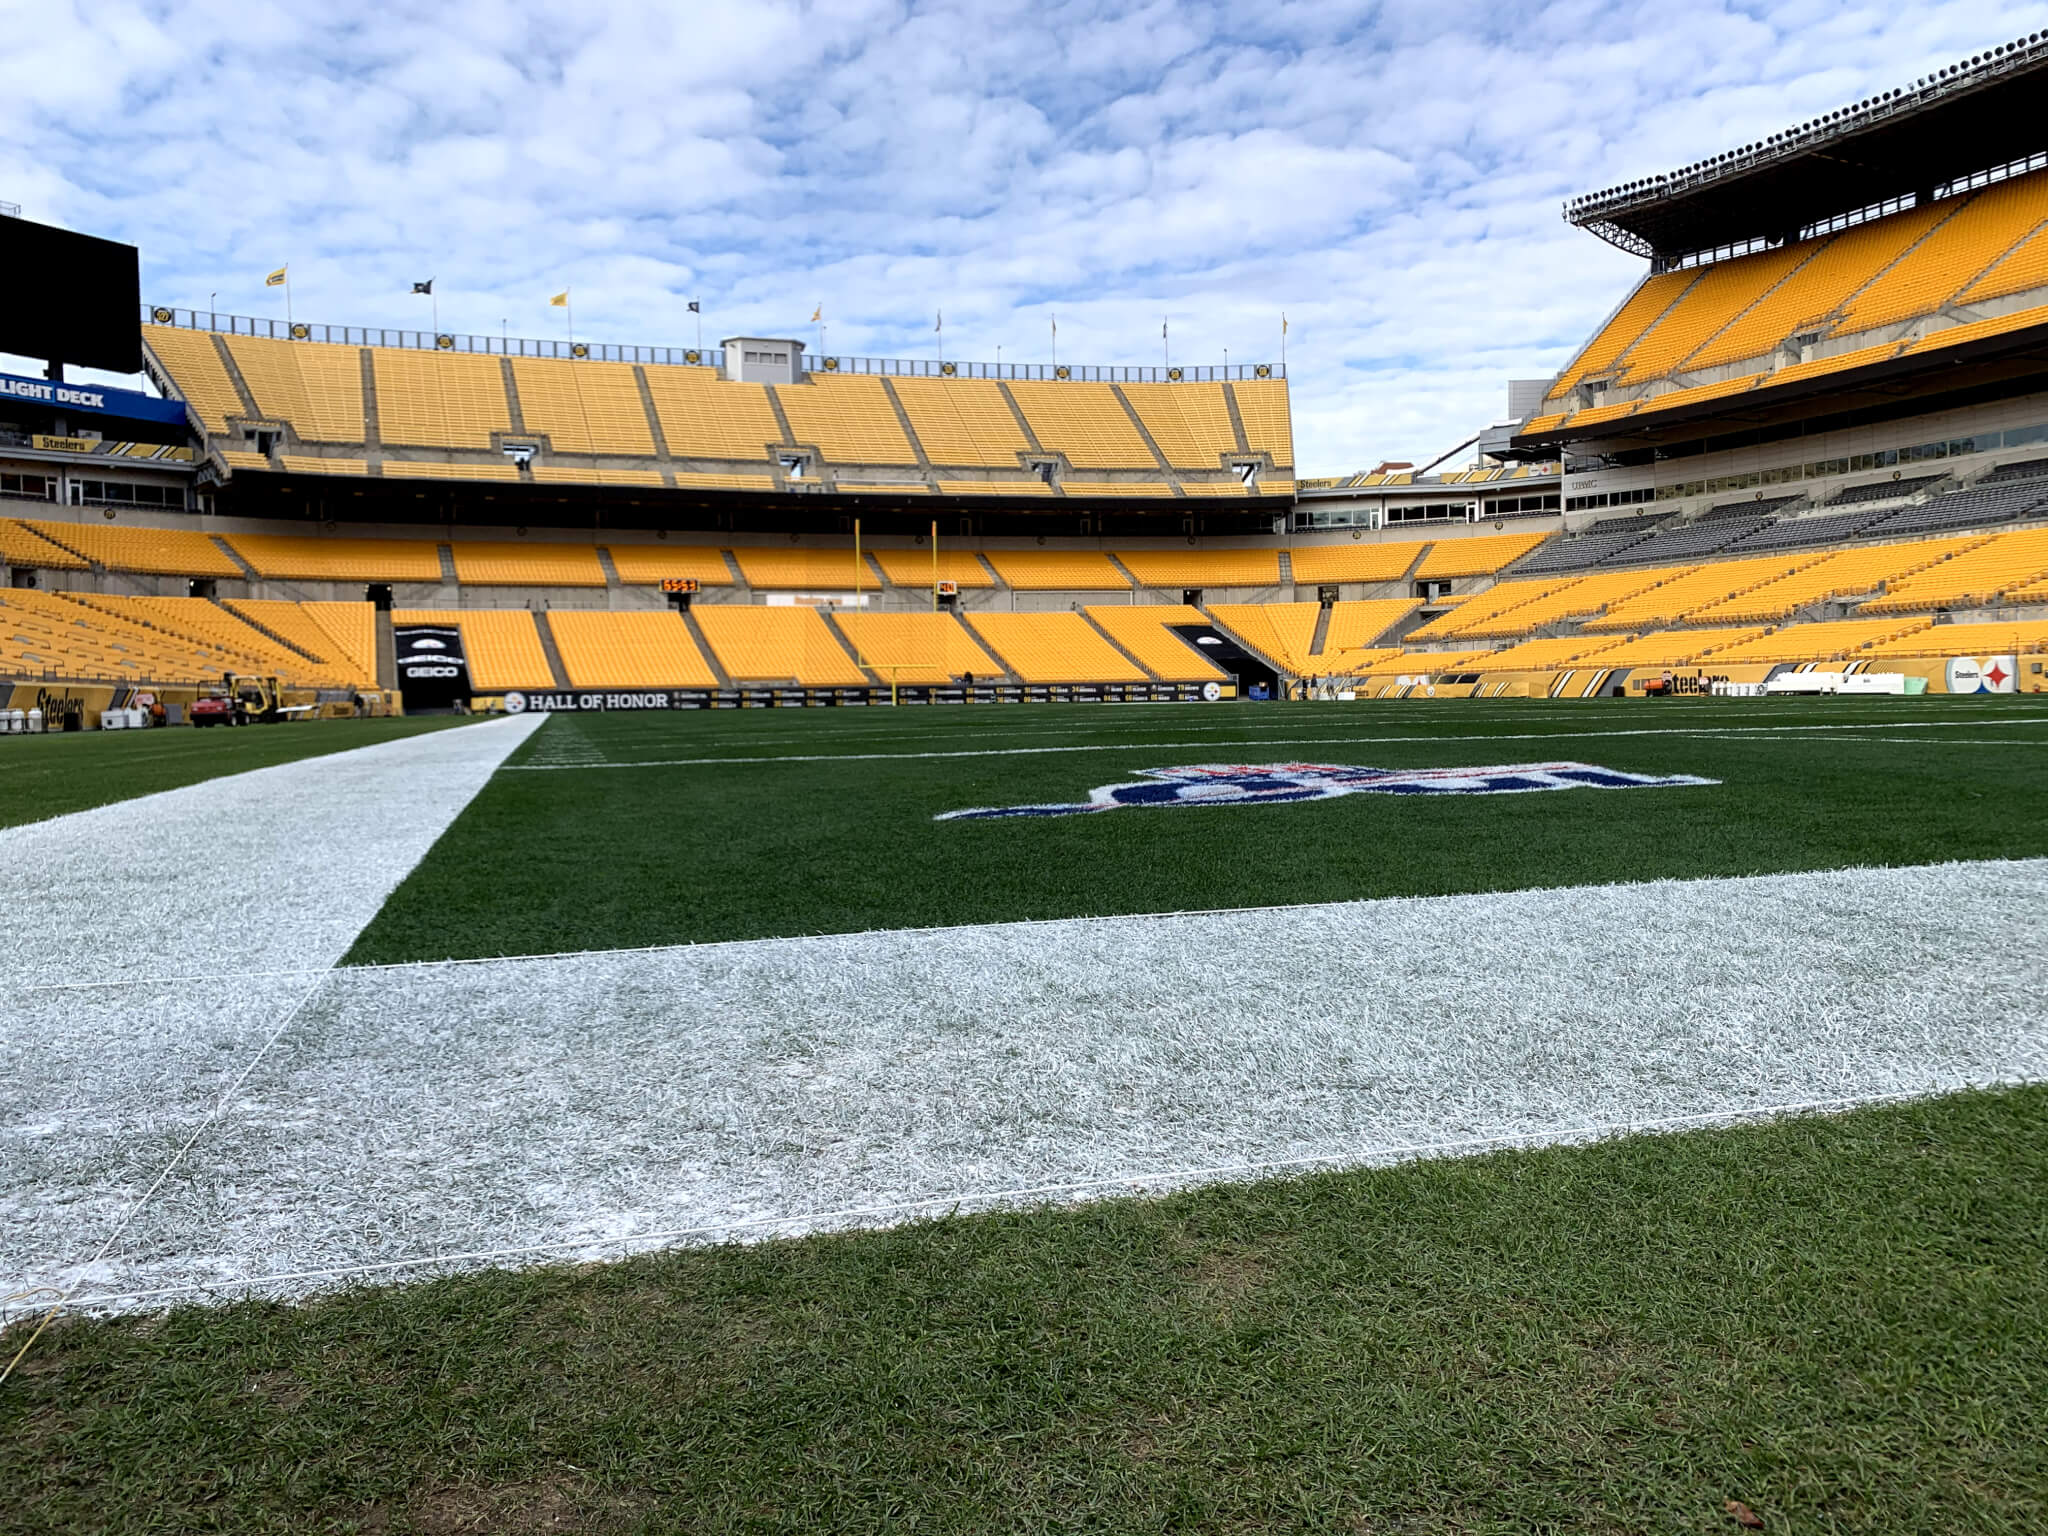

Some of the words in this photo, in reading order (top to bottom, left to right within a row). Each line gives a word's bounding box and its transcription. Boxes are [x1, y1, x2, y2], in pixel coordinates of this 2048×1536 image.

[56, 388, 105, 408] DECK
[43, 437, 85, 450] Steelers
[1300, 479, 1332, 489] Steelers
[406, 666, 459, 678] GEICO
[1954, 670, 1980, 679] Steelers
[529, 695, 577, 710] HALL
[580, 694, 603, 709] OF
[606, 693, 669, 709] HONOR
